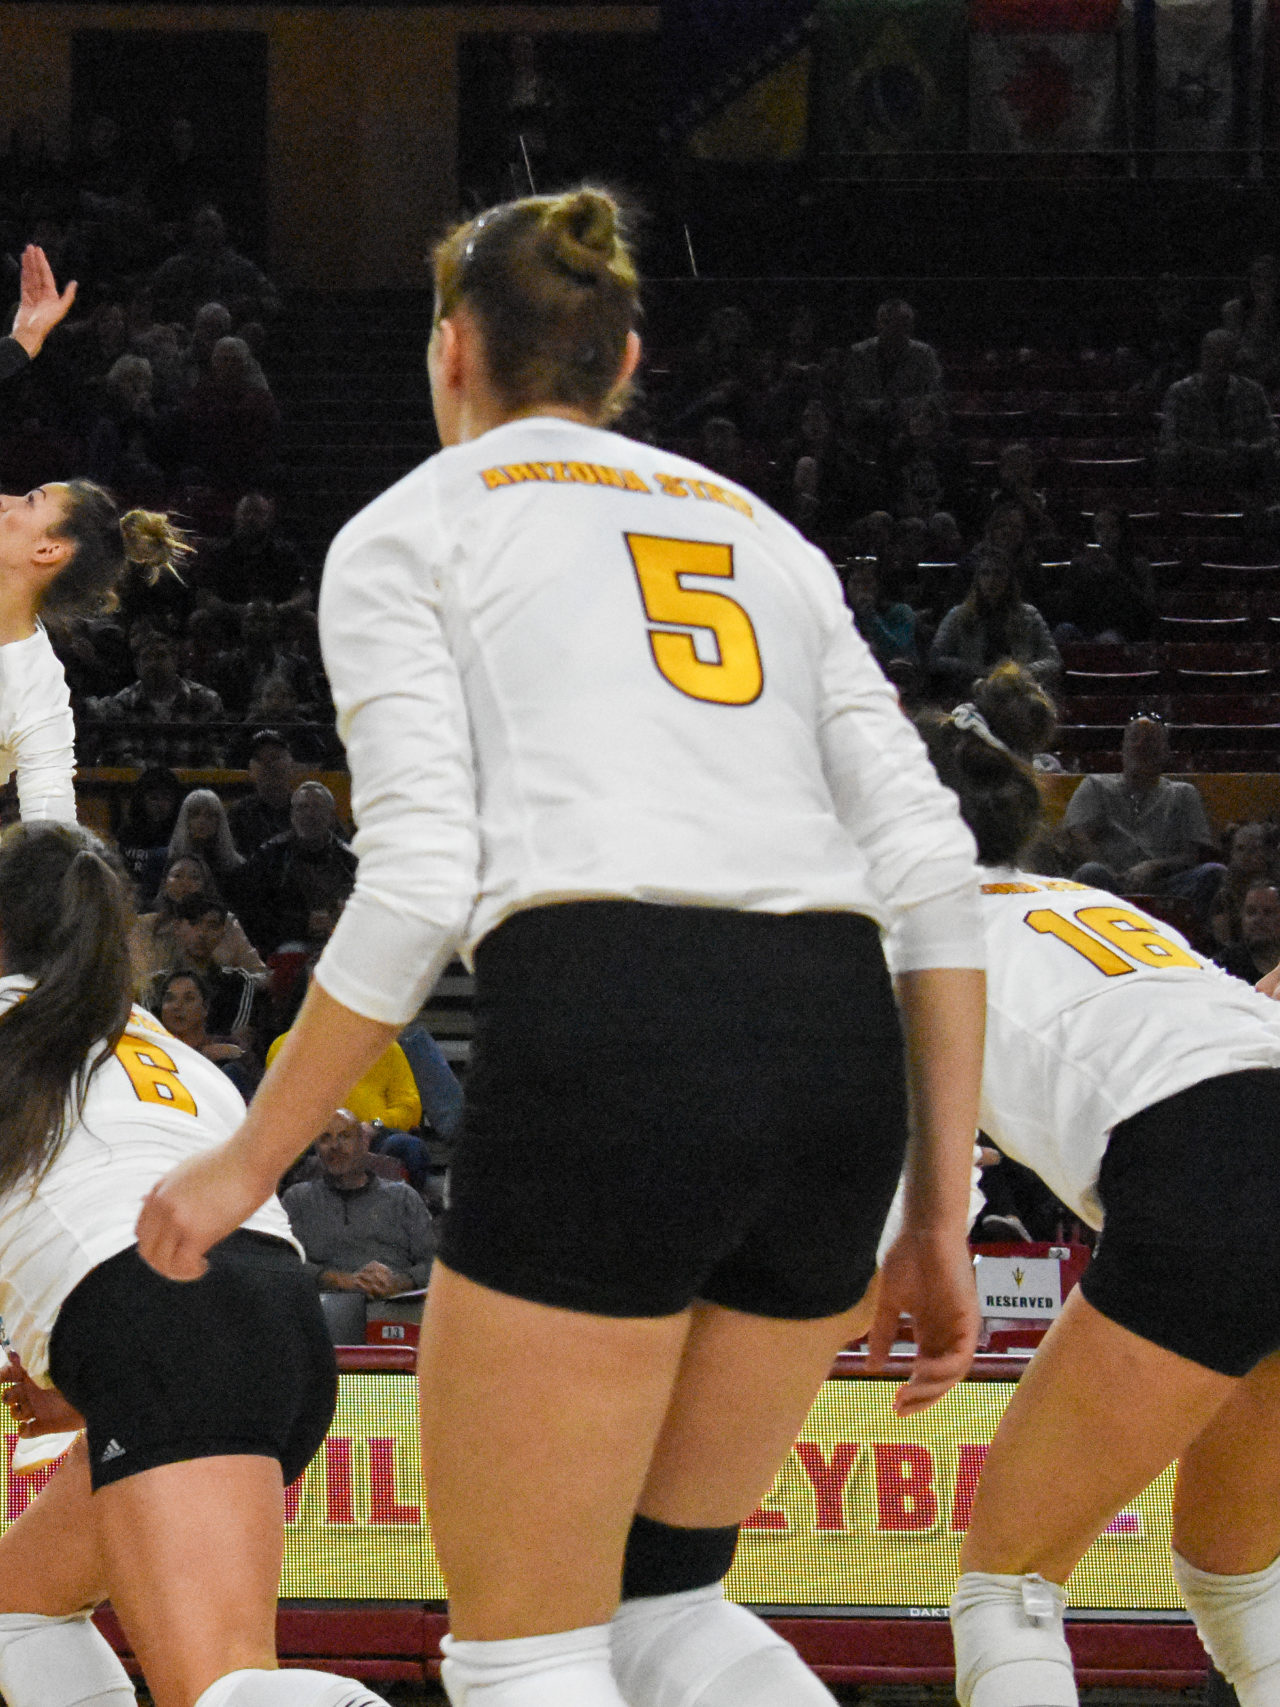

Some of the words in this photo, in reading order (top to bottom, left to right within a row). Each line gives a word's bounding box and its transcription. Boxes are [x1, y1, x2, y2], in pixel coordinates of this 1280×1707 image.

[480, 460, 652, 494] ARIZONA
[623, 531, 764, 707] 5
[1023, 905, 1203, 977] 16
[113, 1033, 198, 1117] 6
[986, 1295, 1053, 1309] RESERVED
